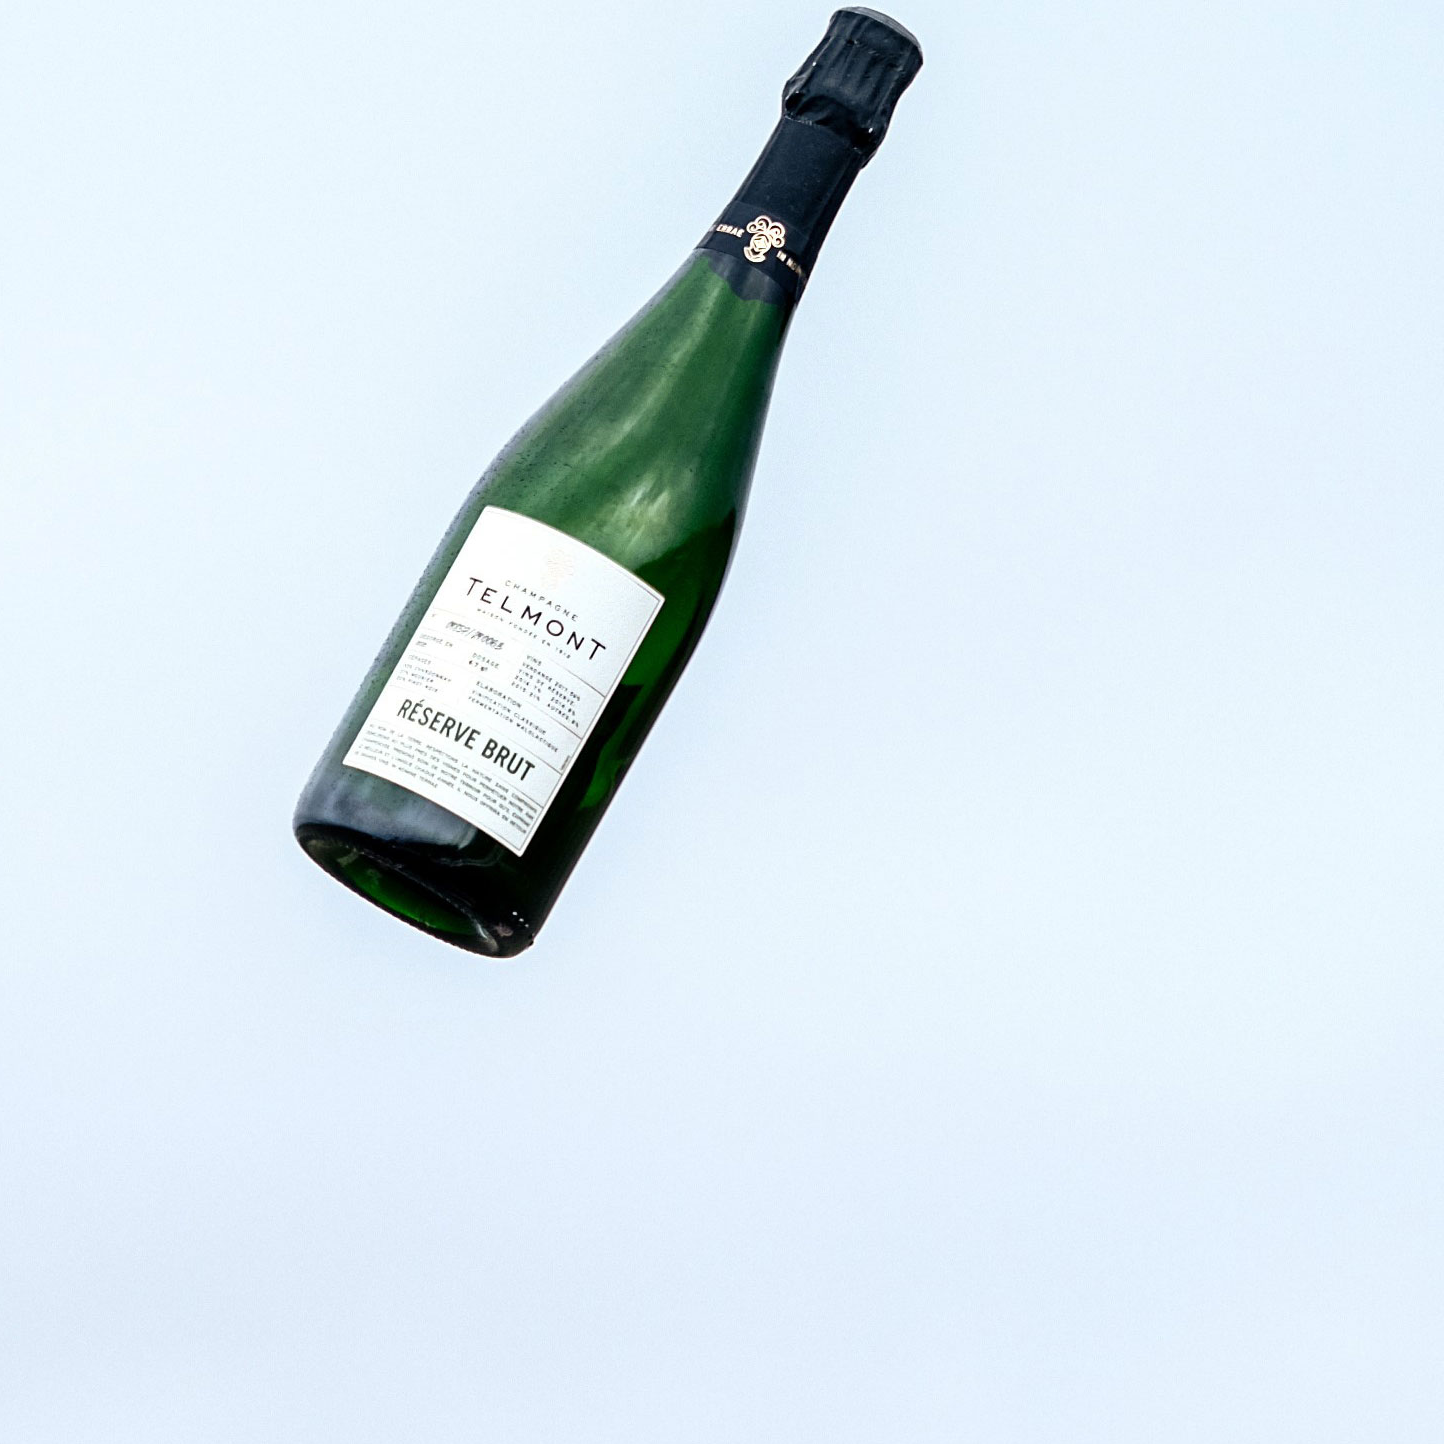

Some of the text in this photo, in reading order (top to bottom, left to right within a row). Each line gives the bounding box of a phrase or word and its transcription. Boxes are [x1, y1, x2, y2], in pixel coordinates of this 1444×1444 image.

[466, 577, 606, 660] TELMONT
[505, 579, 578, 622] CHAMPAGNE
[472, 652, 500, 669] DOSAGE
[396, 698, 535, 781] RÉSERVE BRUT
